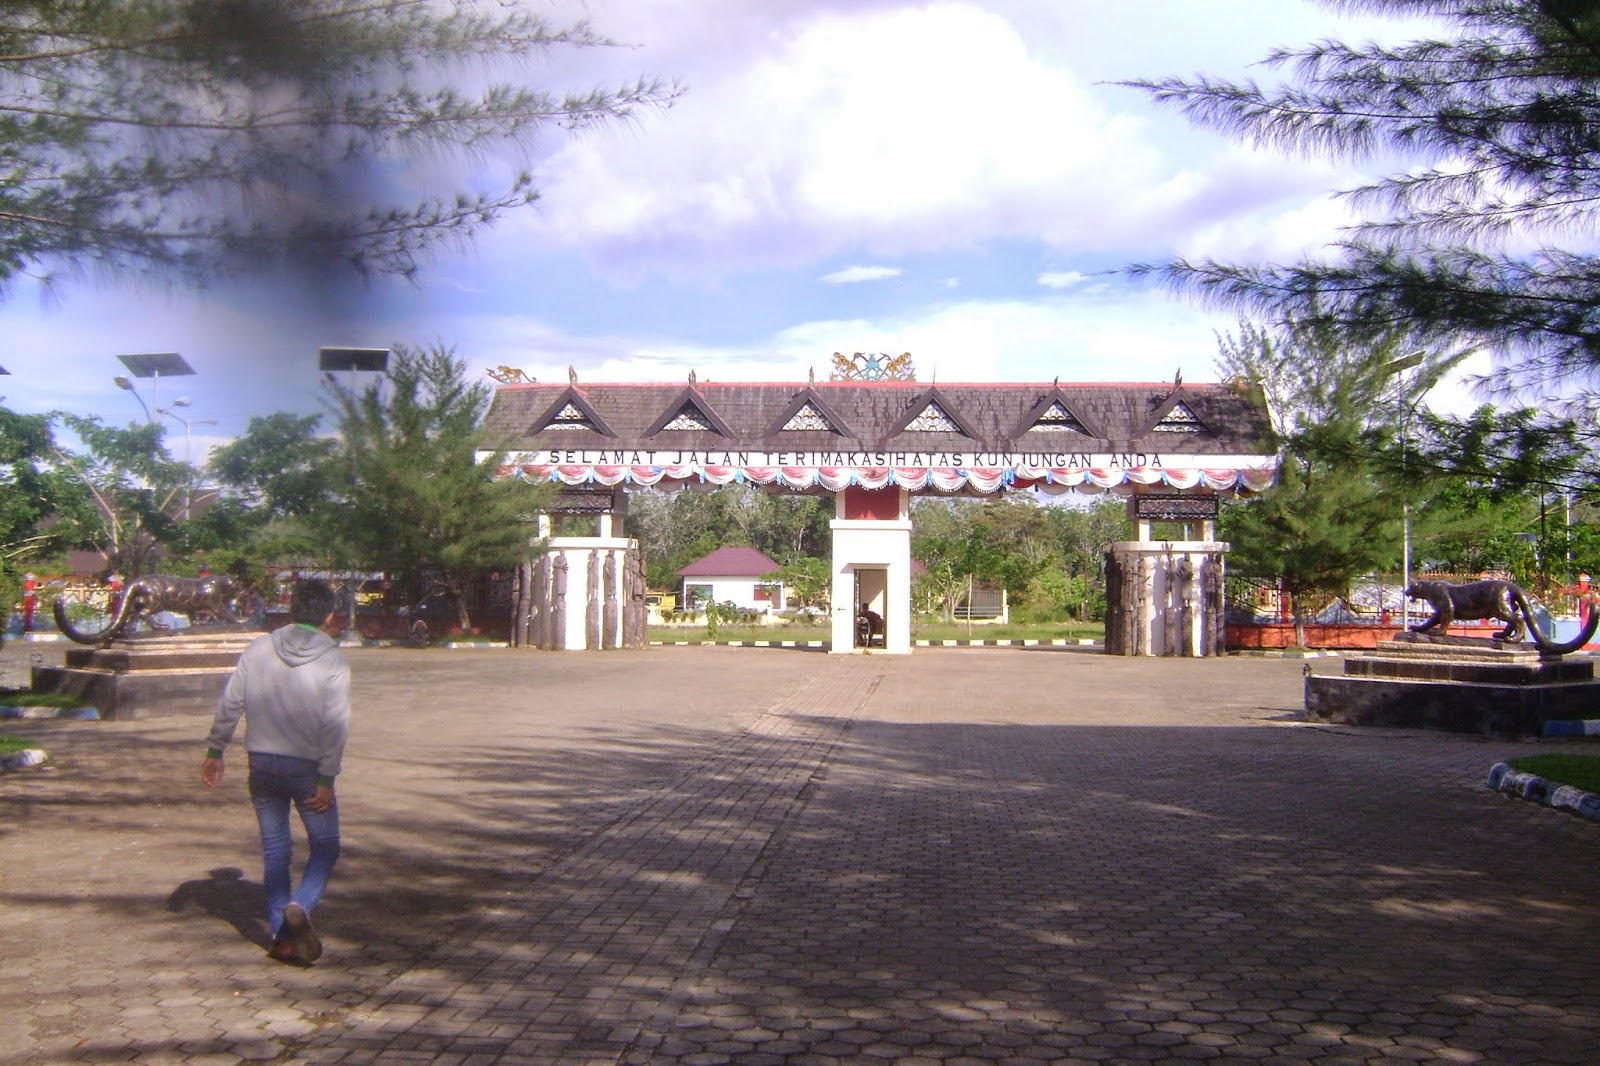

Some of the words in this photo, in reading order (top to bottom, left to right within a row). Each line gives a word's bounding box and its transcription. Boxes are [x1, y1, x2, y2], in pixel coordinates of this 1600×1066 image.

[550, 451, 656, 464] SELAMAT
[672, 451, 749, 466] JALAN
[1109, 453, 1162, 468] ANDA
